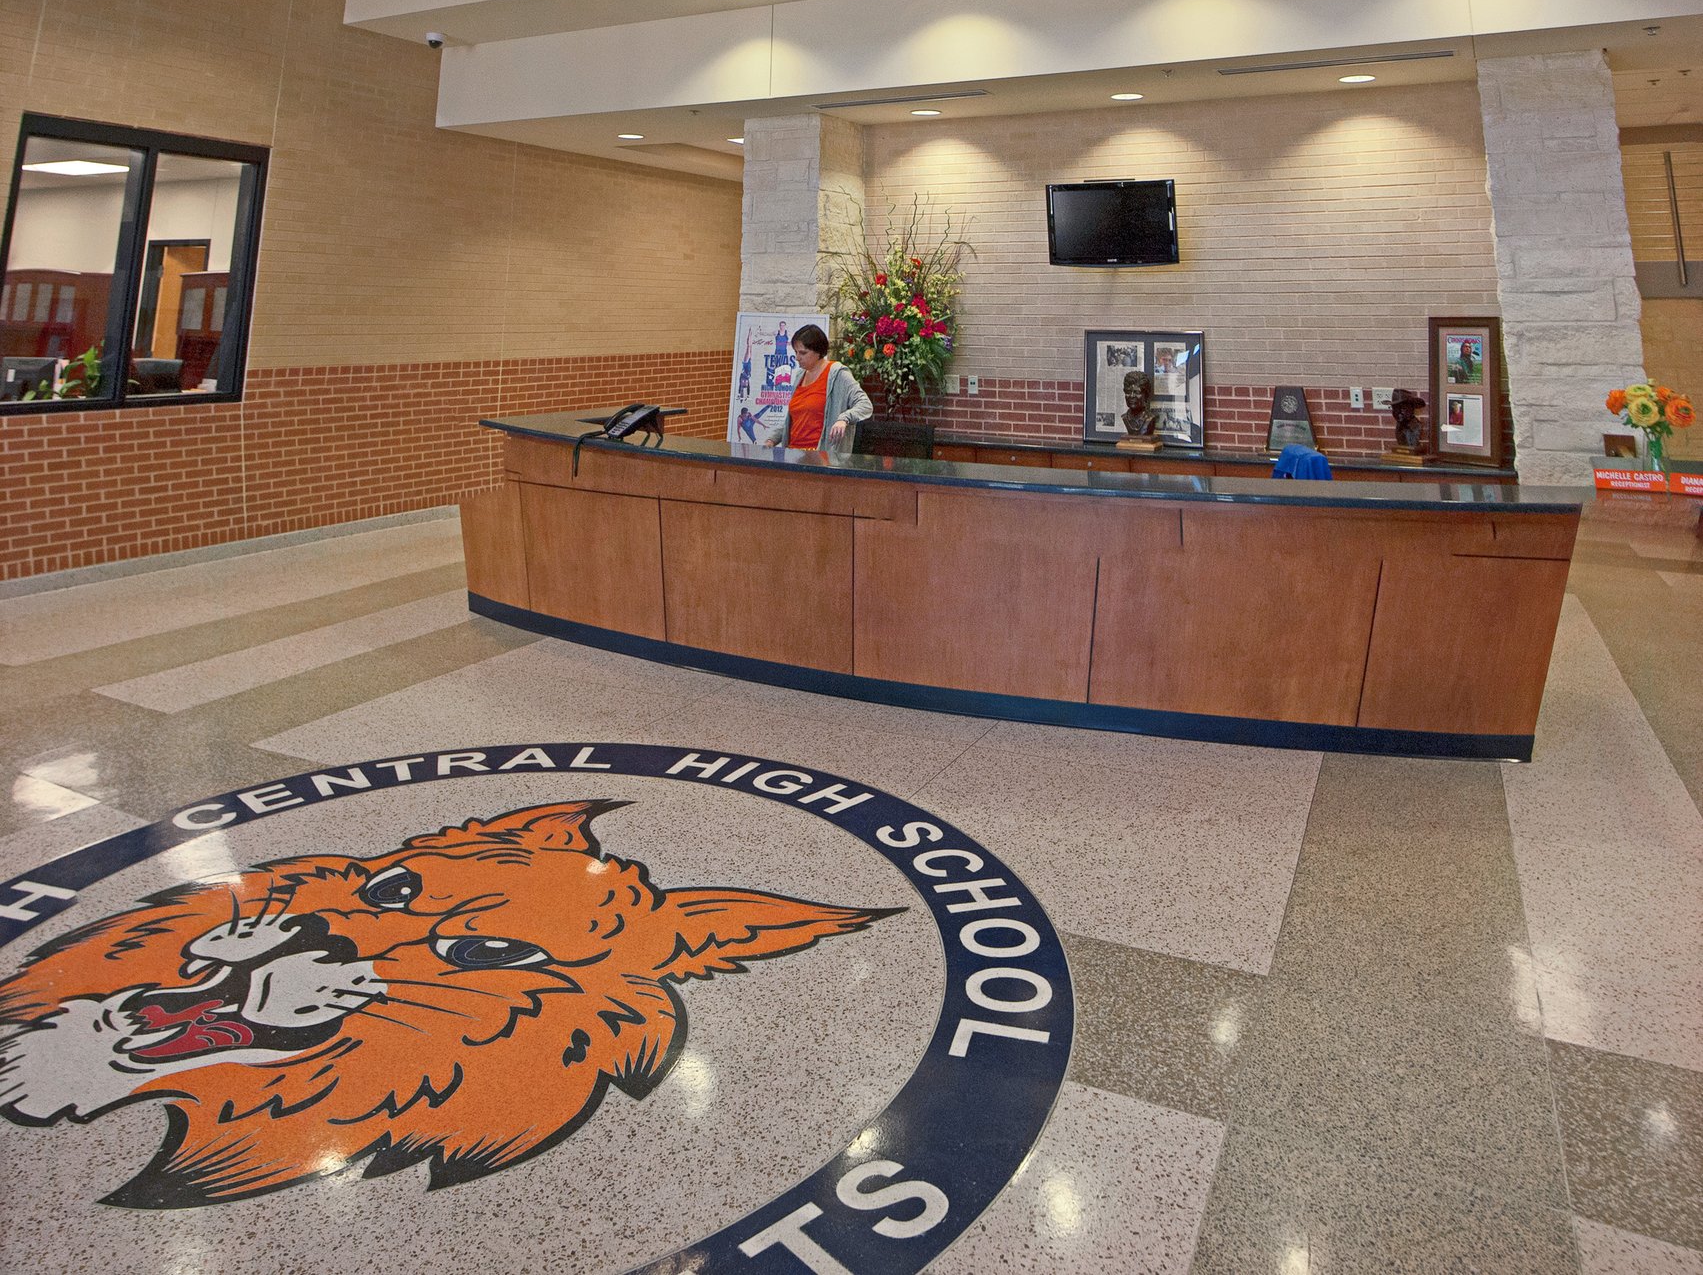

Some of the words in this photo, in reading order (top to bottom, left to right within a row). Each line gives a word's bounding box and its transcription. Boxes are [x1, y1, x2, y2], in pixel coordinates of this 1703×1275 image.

[764, 354, 796, 369] TEXAS
[775, 384, 793, 392] SCHOO
[760, 391, 791, 399] GYMNASTIC
[770, 405, 784, 413] 2012
[1596, 471, 1631, 480] MICHELLE
[1633, 473, 1664, 482] CASTRO
[1610, 480, 1650, 489] RECEPTIONIST
[172, 746, 612, 830] CENTRAL
[665, 752, 875, 815] HIGH
[876, 821, 1053, 1057] SCHOOL
